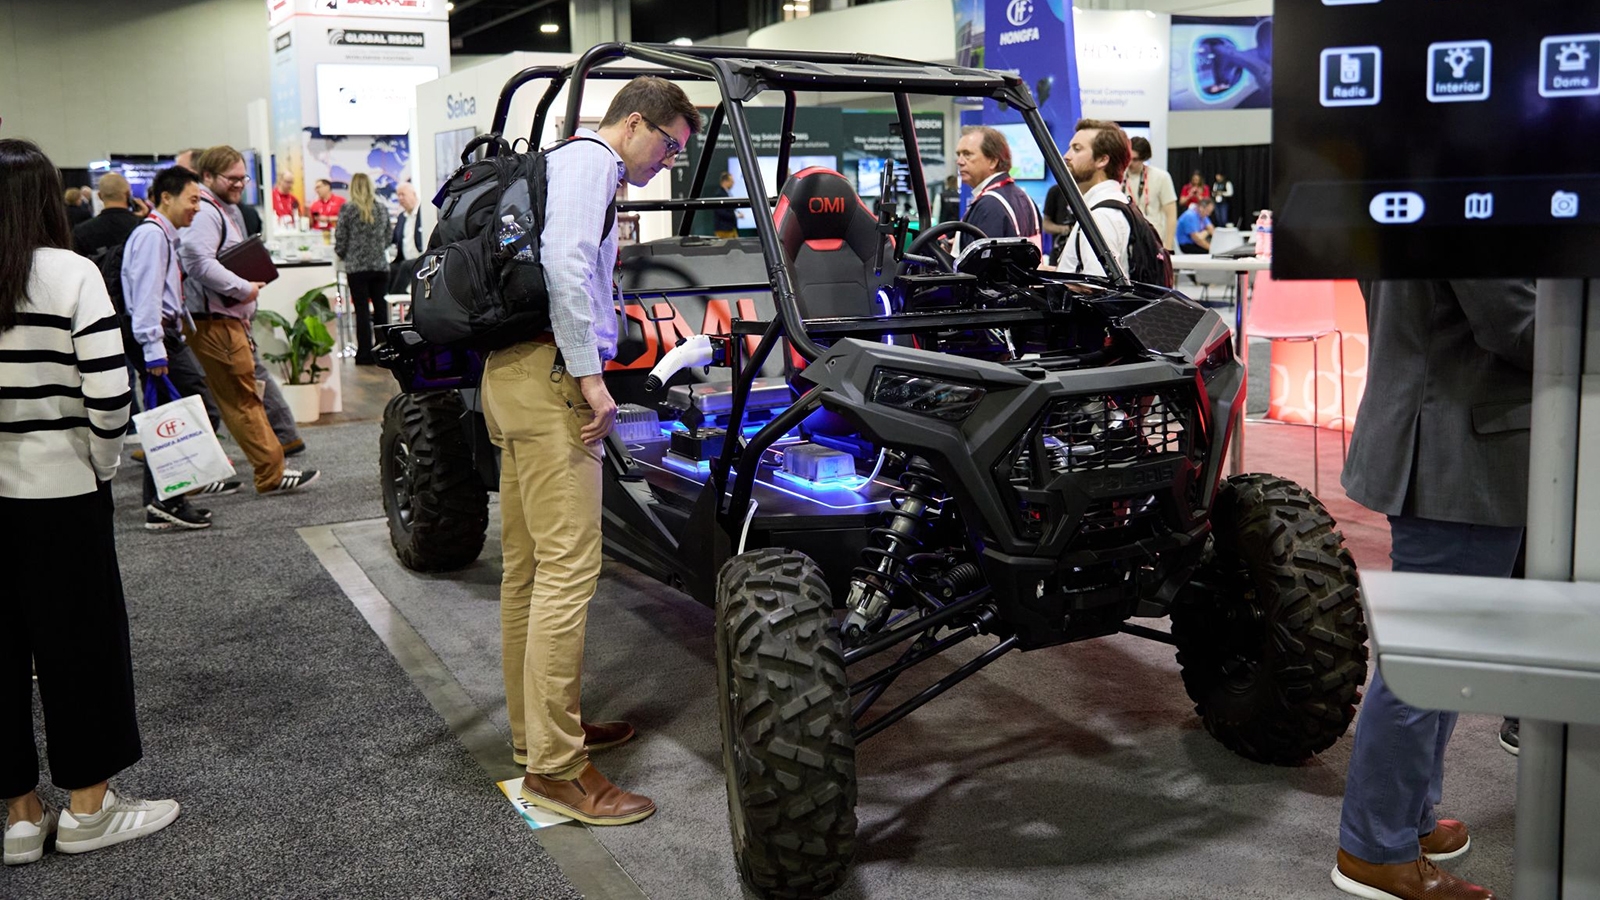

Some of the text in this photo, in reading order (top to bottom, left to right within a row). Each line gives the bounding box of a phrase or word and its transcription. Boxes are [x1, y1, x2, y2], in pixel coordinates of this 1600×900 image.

[345, 33, 423, 46] GLOBAL REACH
[1000, 27, 1039, 46] HONGFA
[1083, 43, 1159, 59] HON
[1435, 81, 1481, 93] Interior
[1553, 76, 1590, 88] Dome
[1333, 86, 1367, 98] Radio
[447, 92, 476, 119] Seica
[914, 119, 942, 129] BOSCH
[808, 196, 845, 214] OMI
[150, 430, 203, 453] HONGFA AMERICA
